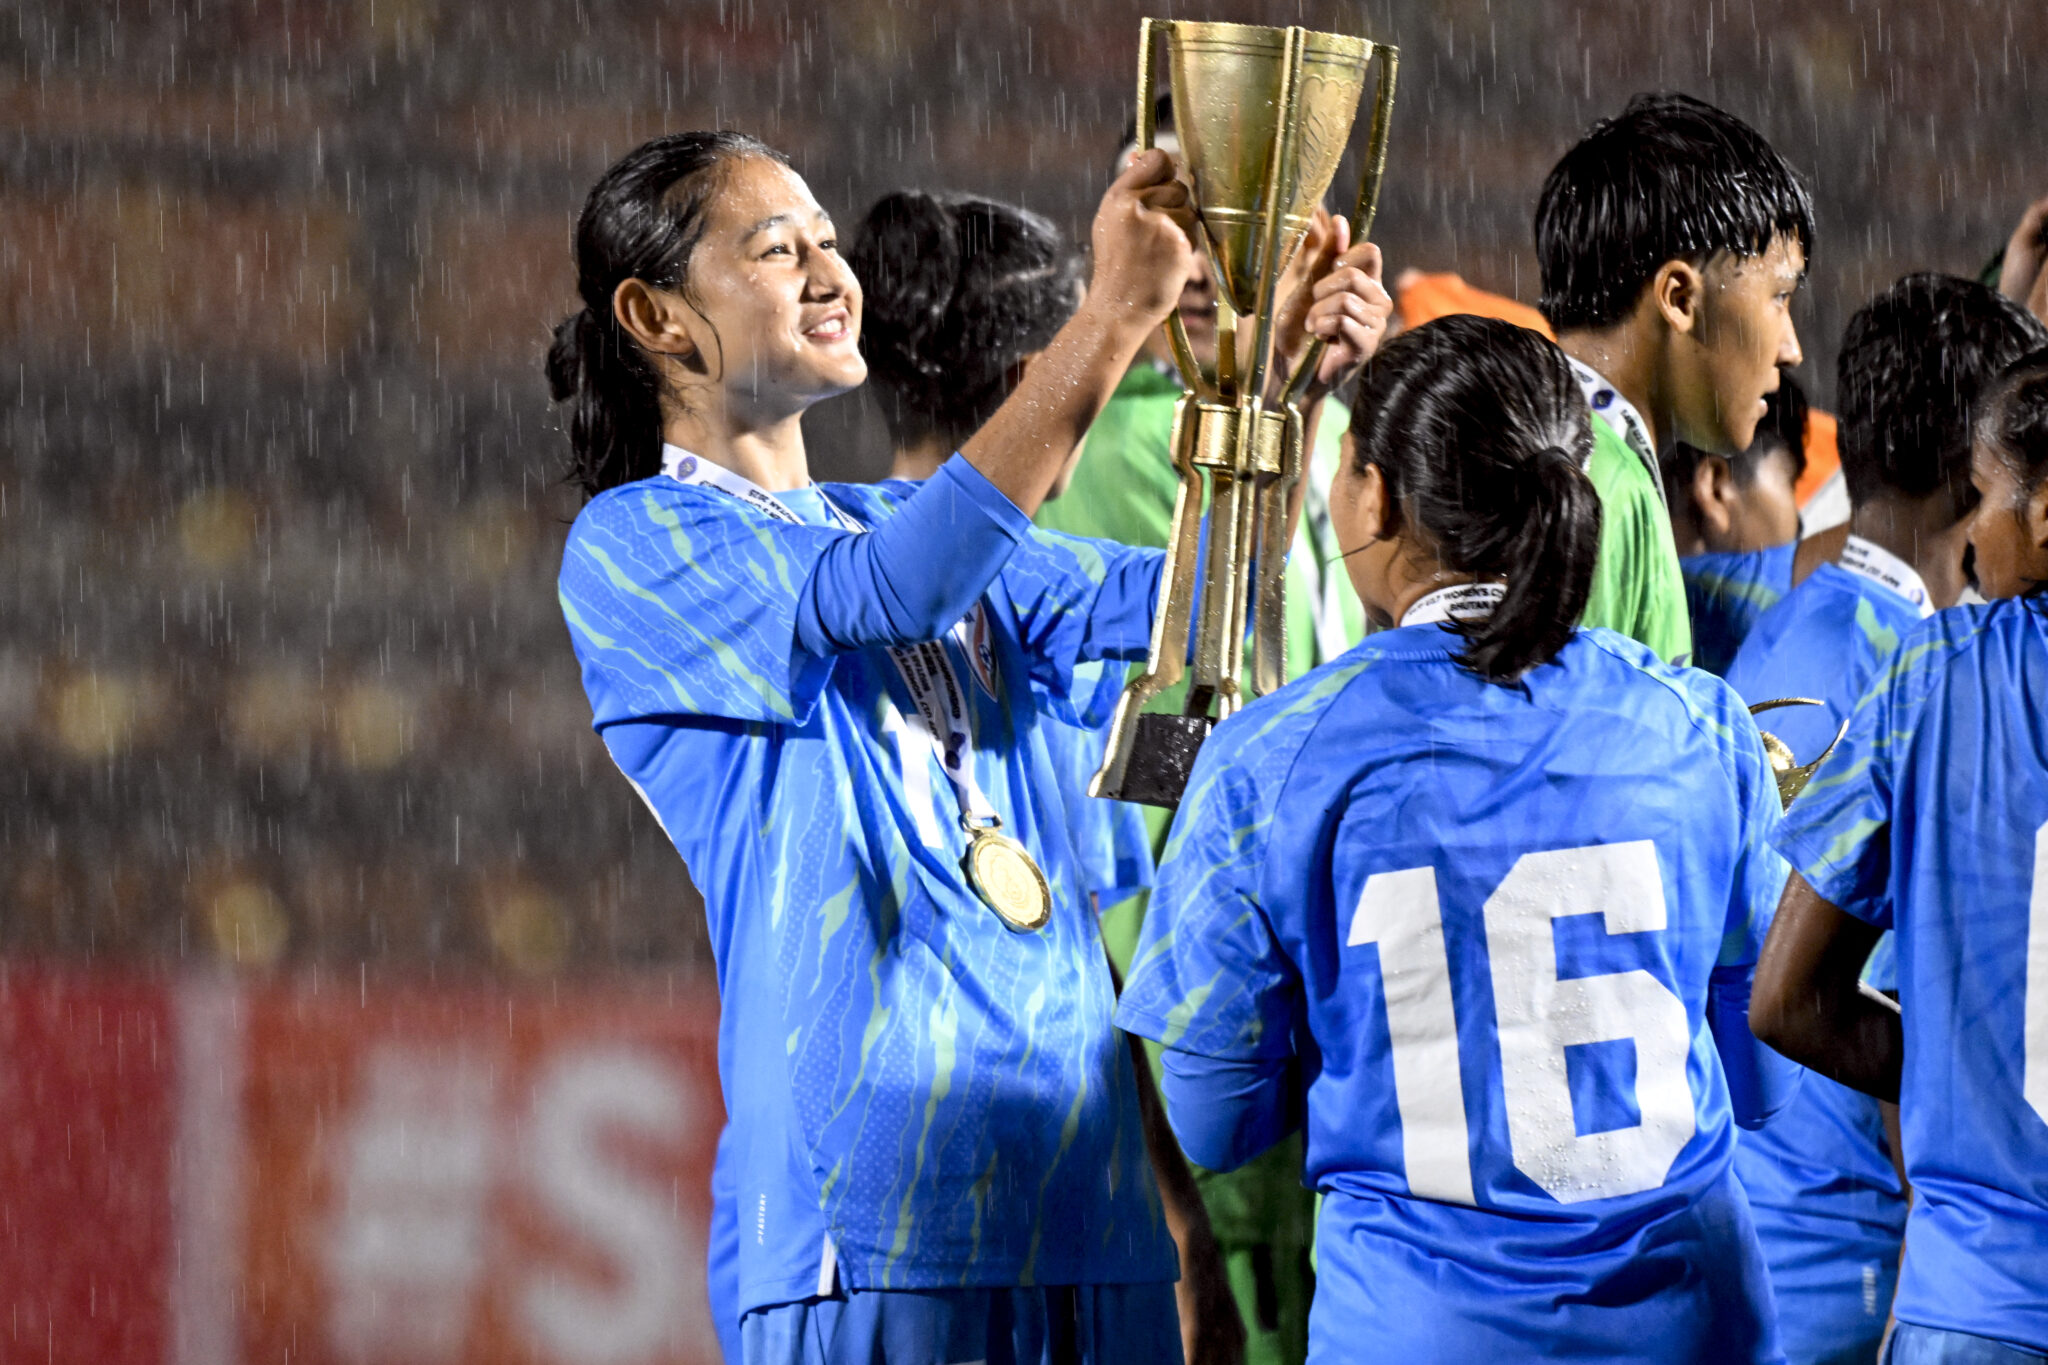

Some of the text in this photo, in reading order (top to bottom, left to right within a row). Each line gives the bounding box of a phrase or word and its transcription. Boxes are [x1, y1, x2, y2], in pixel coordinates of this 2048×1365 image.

[1443, 587, 1488, 601] WOMEN'S
[1450, 600, 1488, 612] BHUTAN
[899, 657, 924, 700] WOMEN'S
[919, 701, 933, 719] U17
[1346, 838, 1698, 1206] 16
